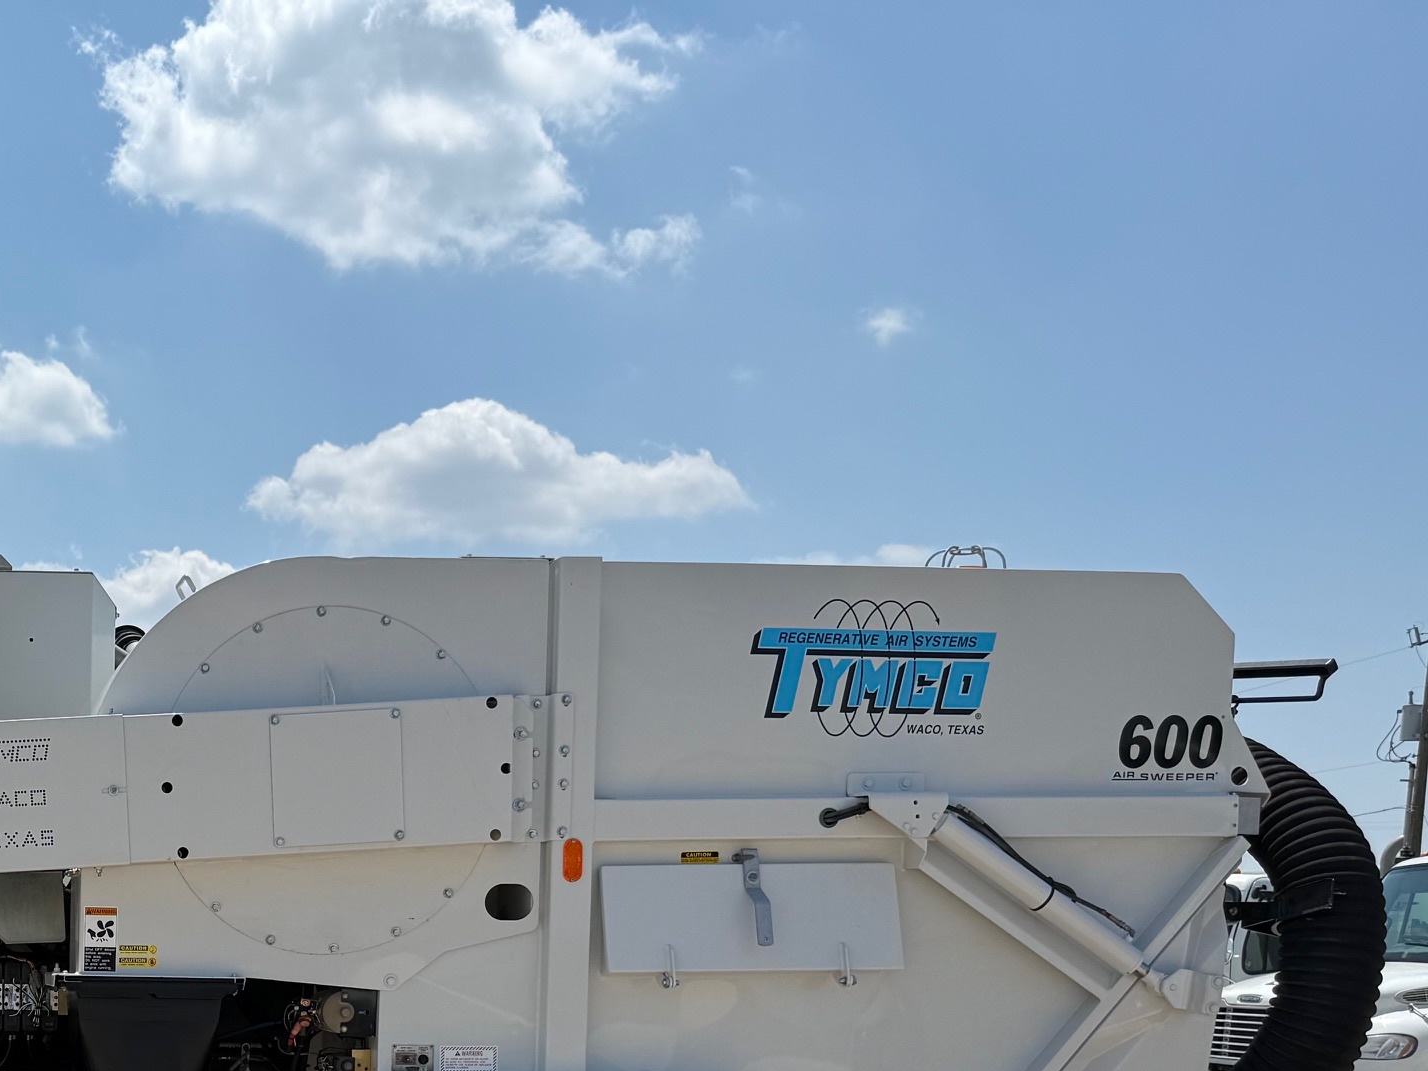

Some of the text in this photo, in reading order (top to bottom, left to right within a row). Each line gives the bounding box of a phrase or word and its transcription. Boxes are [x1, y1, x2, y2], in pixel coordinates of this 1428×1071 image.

[778, 631, 978, 648] REGENERATIVE AIR SYSTEMS
[750, 627, 997, 719] TYMCO
[906, 724, 985, 736] WACO, TEXAS
[1118, 714, 1224, 769] 600
[1112, 771, 1215, 781] AIR SWEEPER
